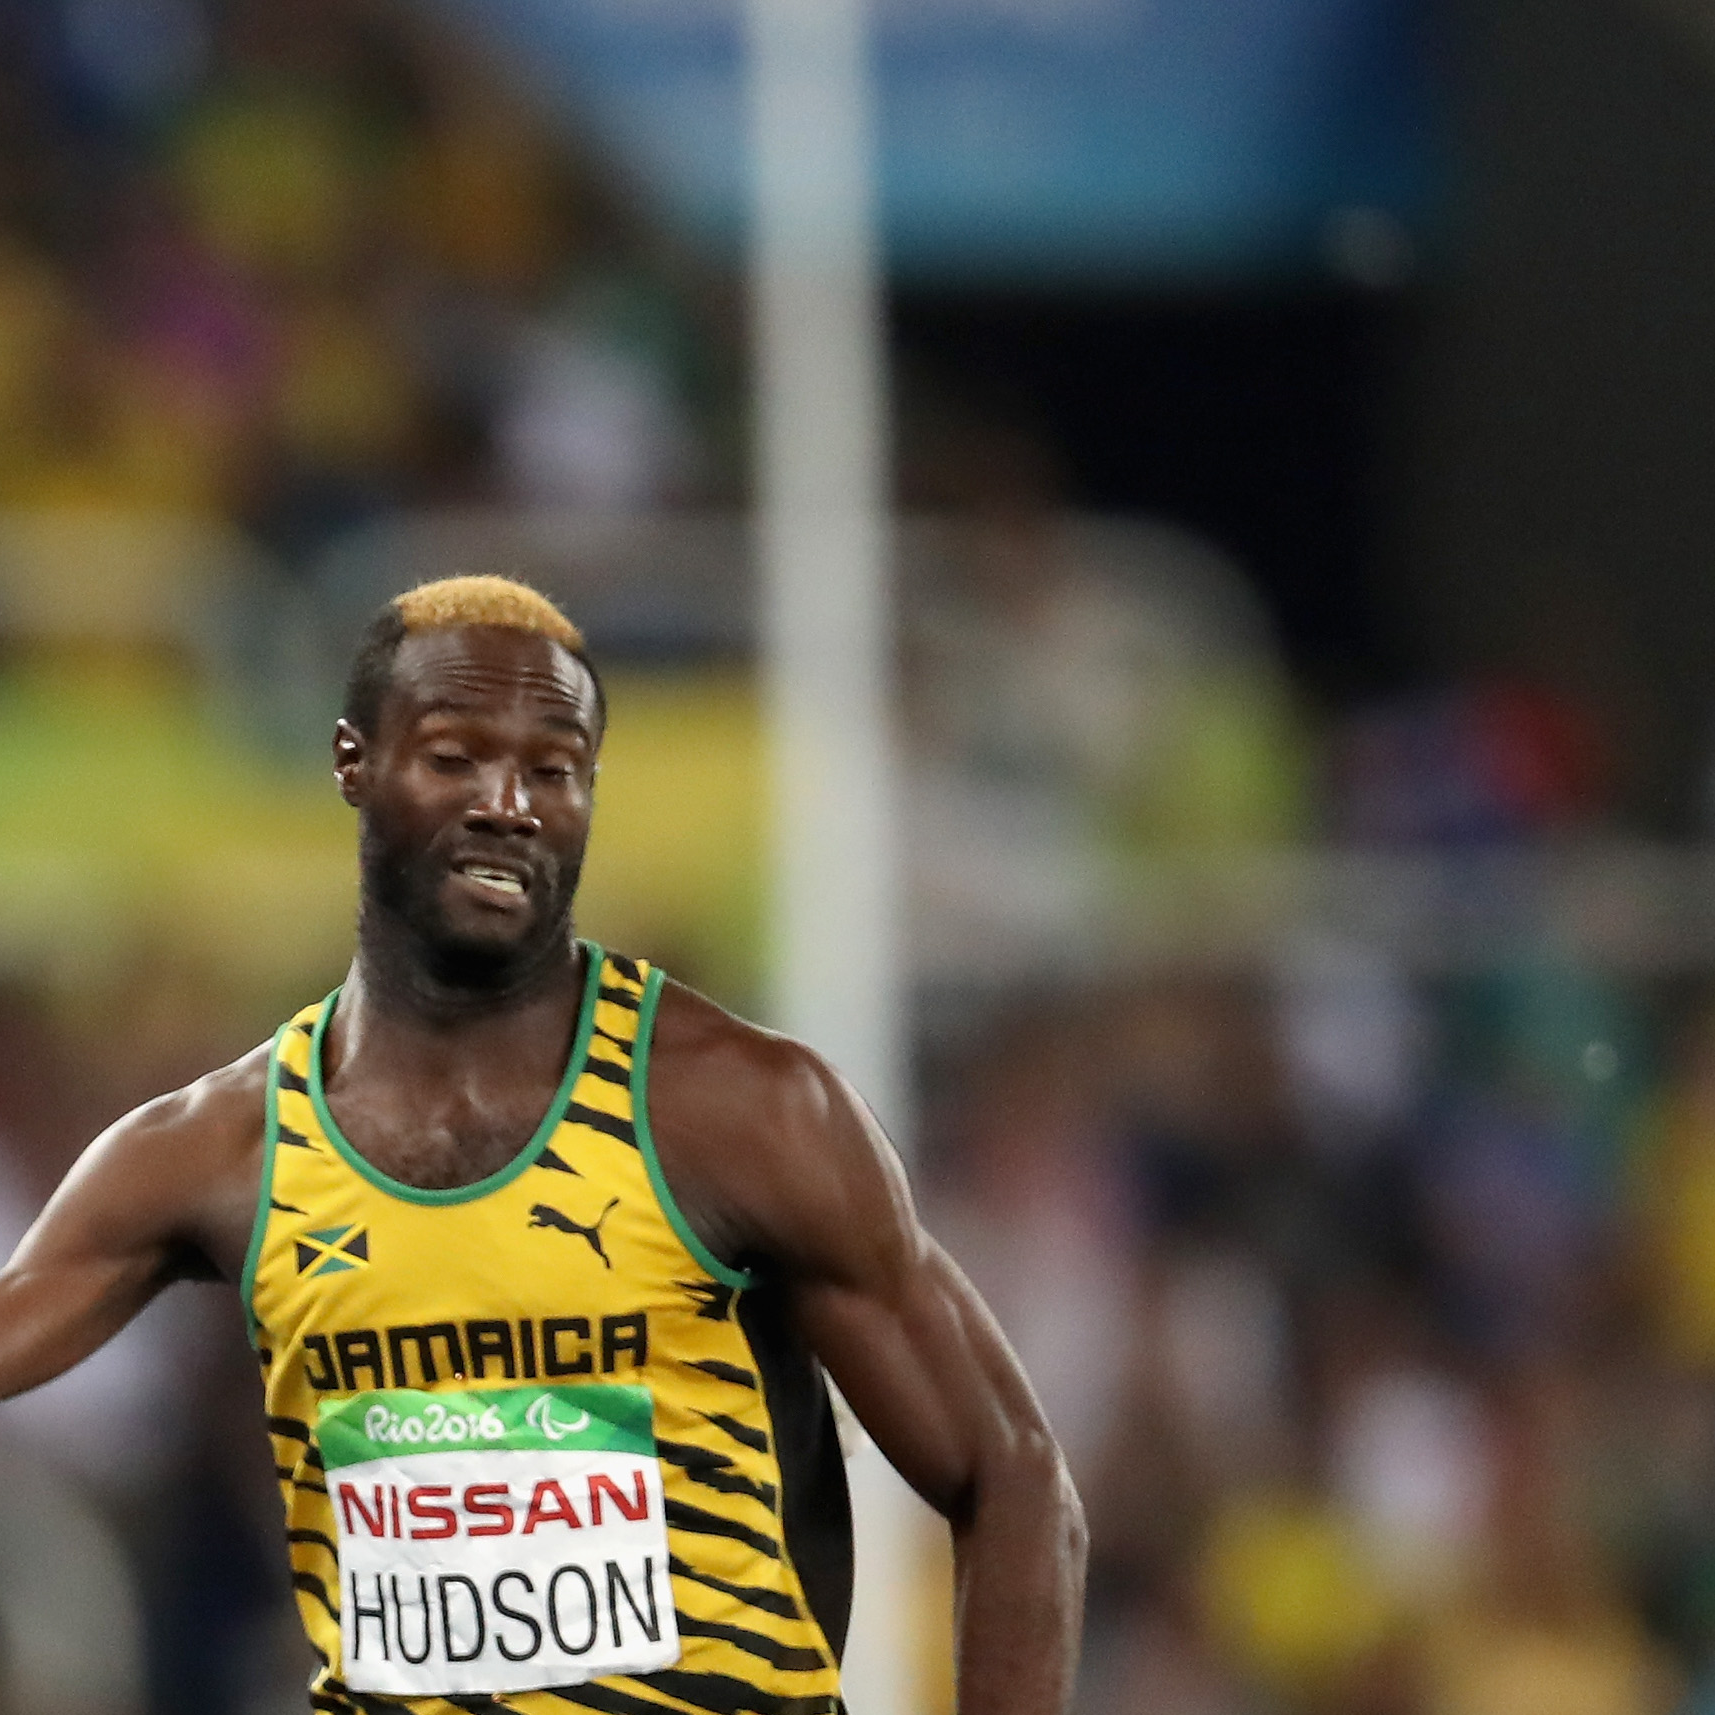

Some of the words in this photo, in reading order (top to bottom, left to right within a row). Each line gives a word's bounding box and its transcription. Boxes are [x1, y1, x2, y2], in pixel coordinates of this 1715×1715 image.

[303, 1312, 648, 1391] JAMAICA
[338, 1470, 650, 1541] NISSAN
[350, 1556, 662, 1665] HUDSON
